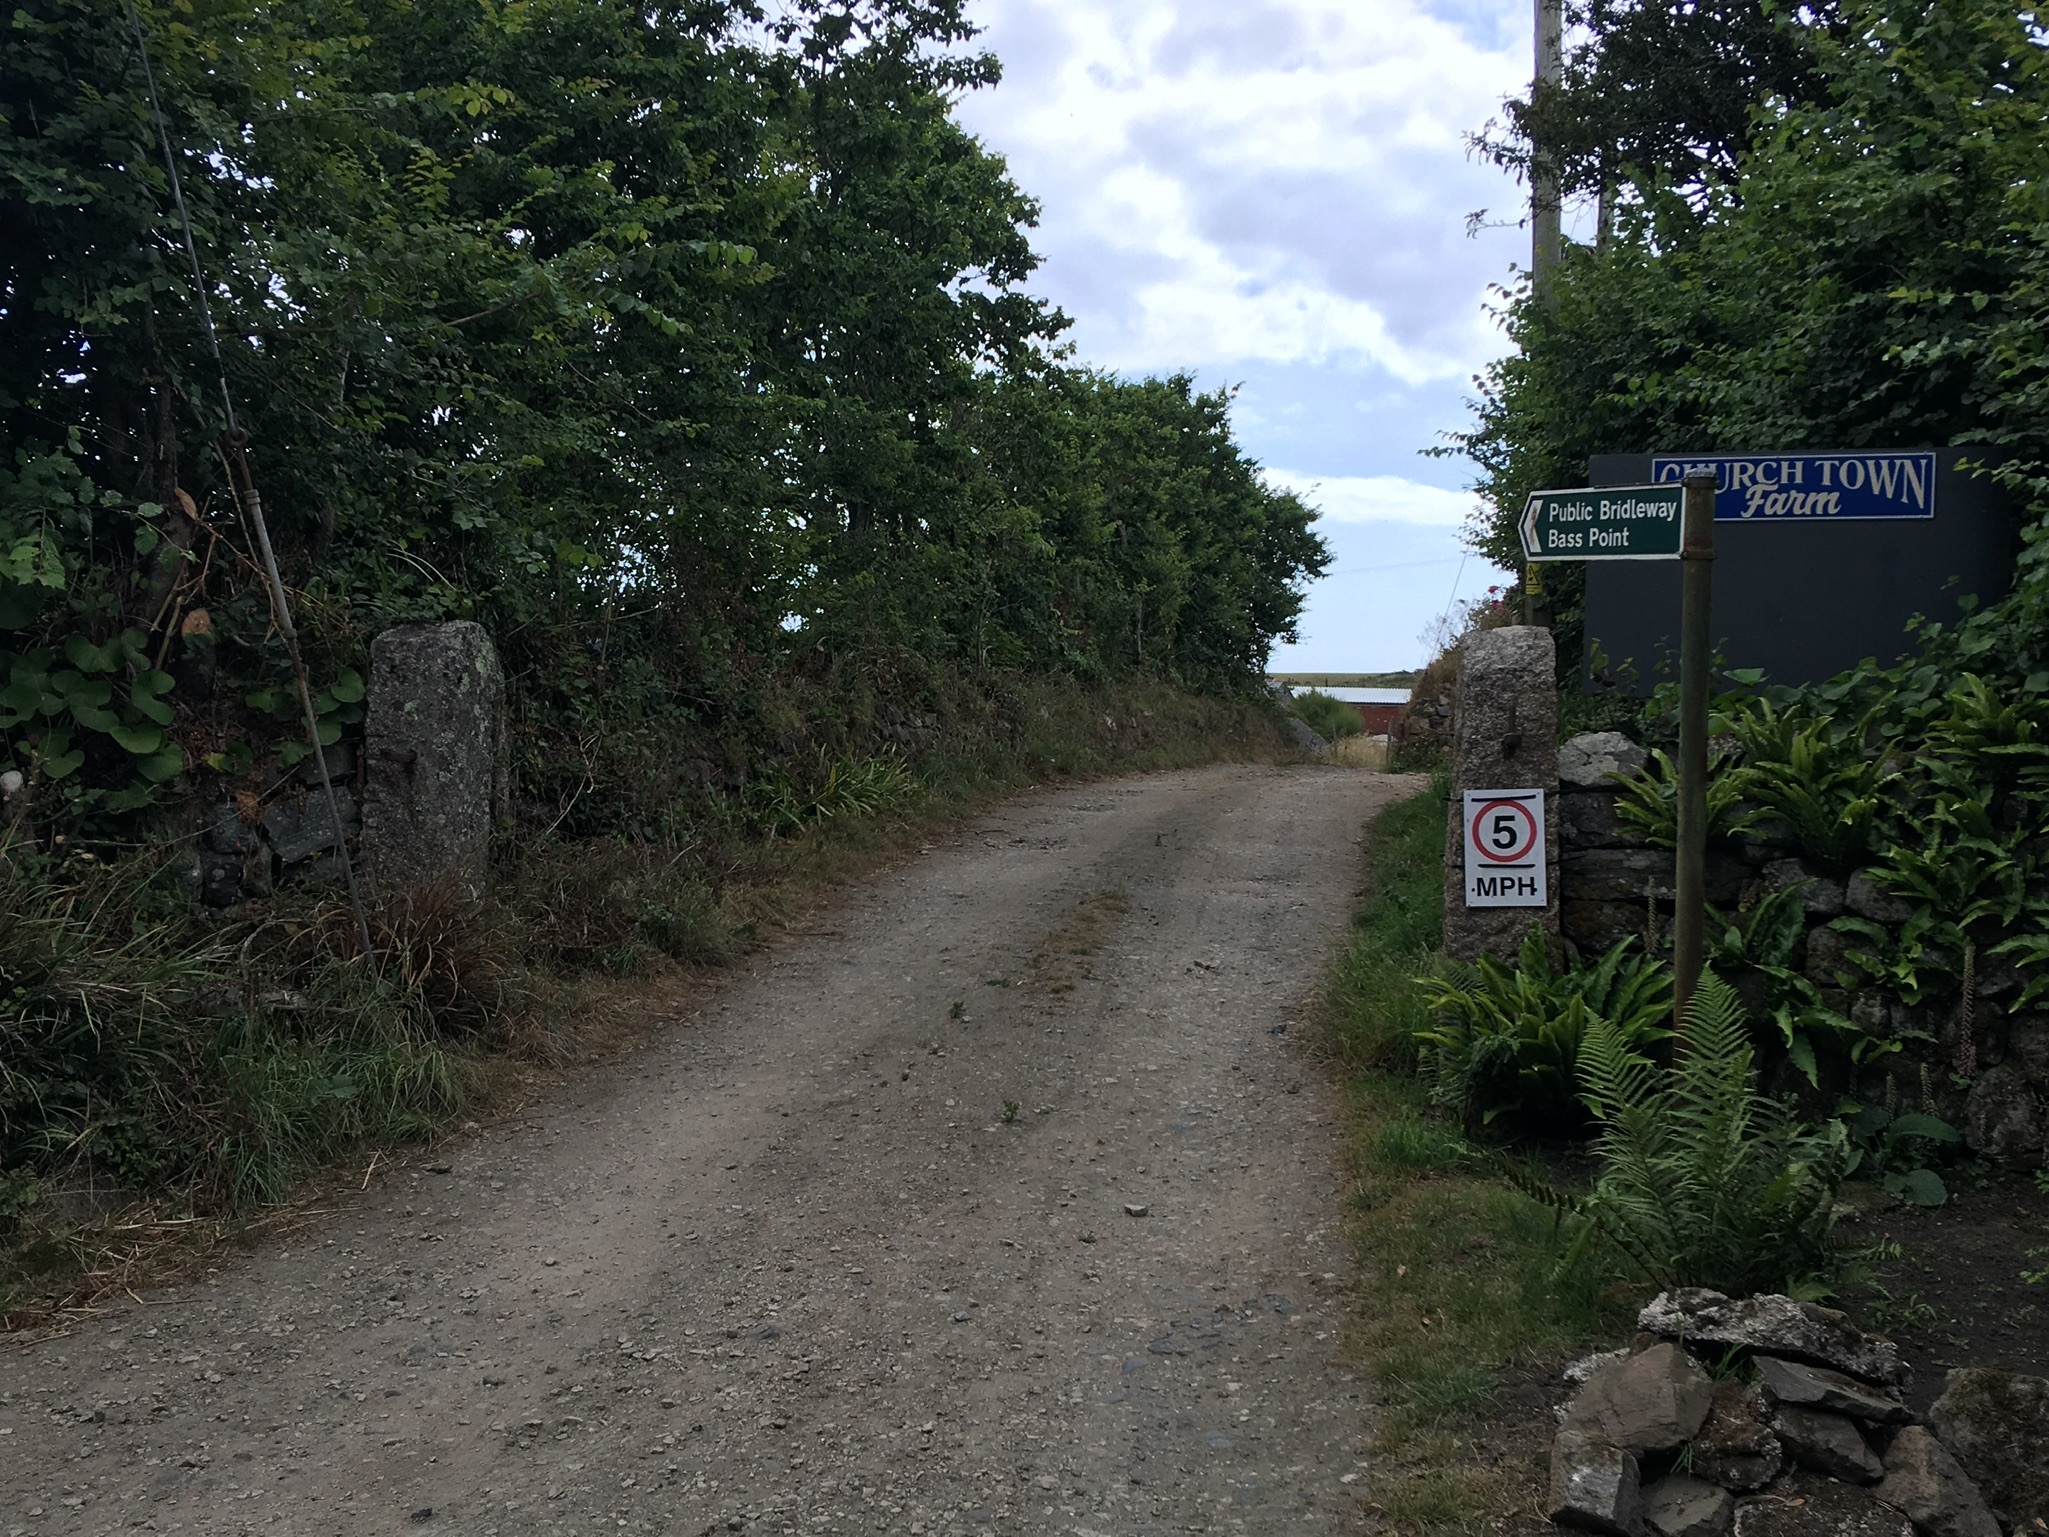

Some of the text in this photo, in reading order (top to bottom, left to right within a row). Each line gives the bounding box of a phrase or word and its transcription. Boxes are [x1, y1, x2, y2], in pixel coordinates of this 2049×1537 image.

[1659, 459, 1928, 509] CURCH TOWN
[1549, 499, 1677, 522] Public Bridleway
[1740, 482, 1842, 518] Farm
[1548, 527, 1629, 548] Bass Point
[1492, 815, 1517, 849] 5
[1476, 876, 1535, 897] MPH
